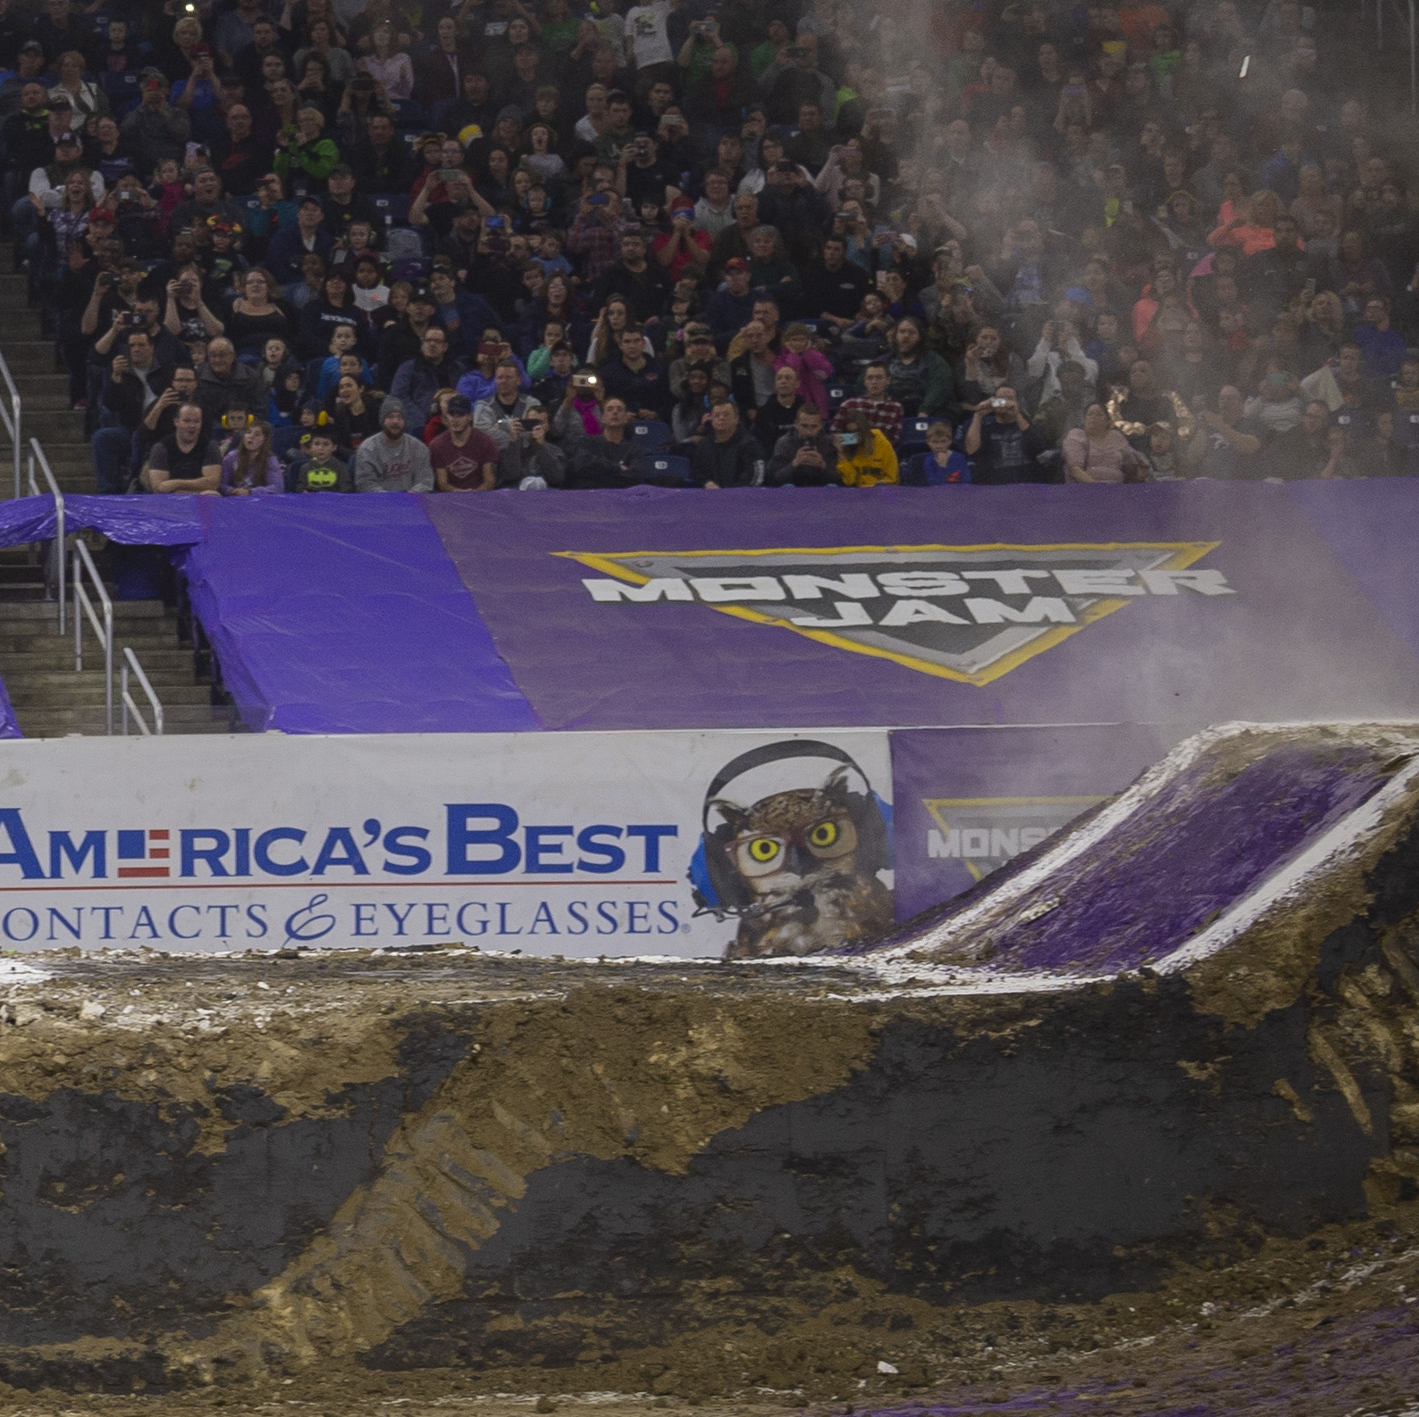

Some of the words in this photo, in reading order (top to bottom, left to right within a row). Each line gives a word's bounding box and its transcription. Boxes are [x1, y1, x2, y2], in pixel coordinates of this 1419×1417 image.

[580, 566, 1240, 605] MONSTER
[788, 596, 1079, 628] JAM
[441, 801, 679, 877] BEST
[926, 826, 1063, 858] MONS
[284, 892, 338, 949] &
[354, 897, 681, 939] EYEGLASSES
